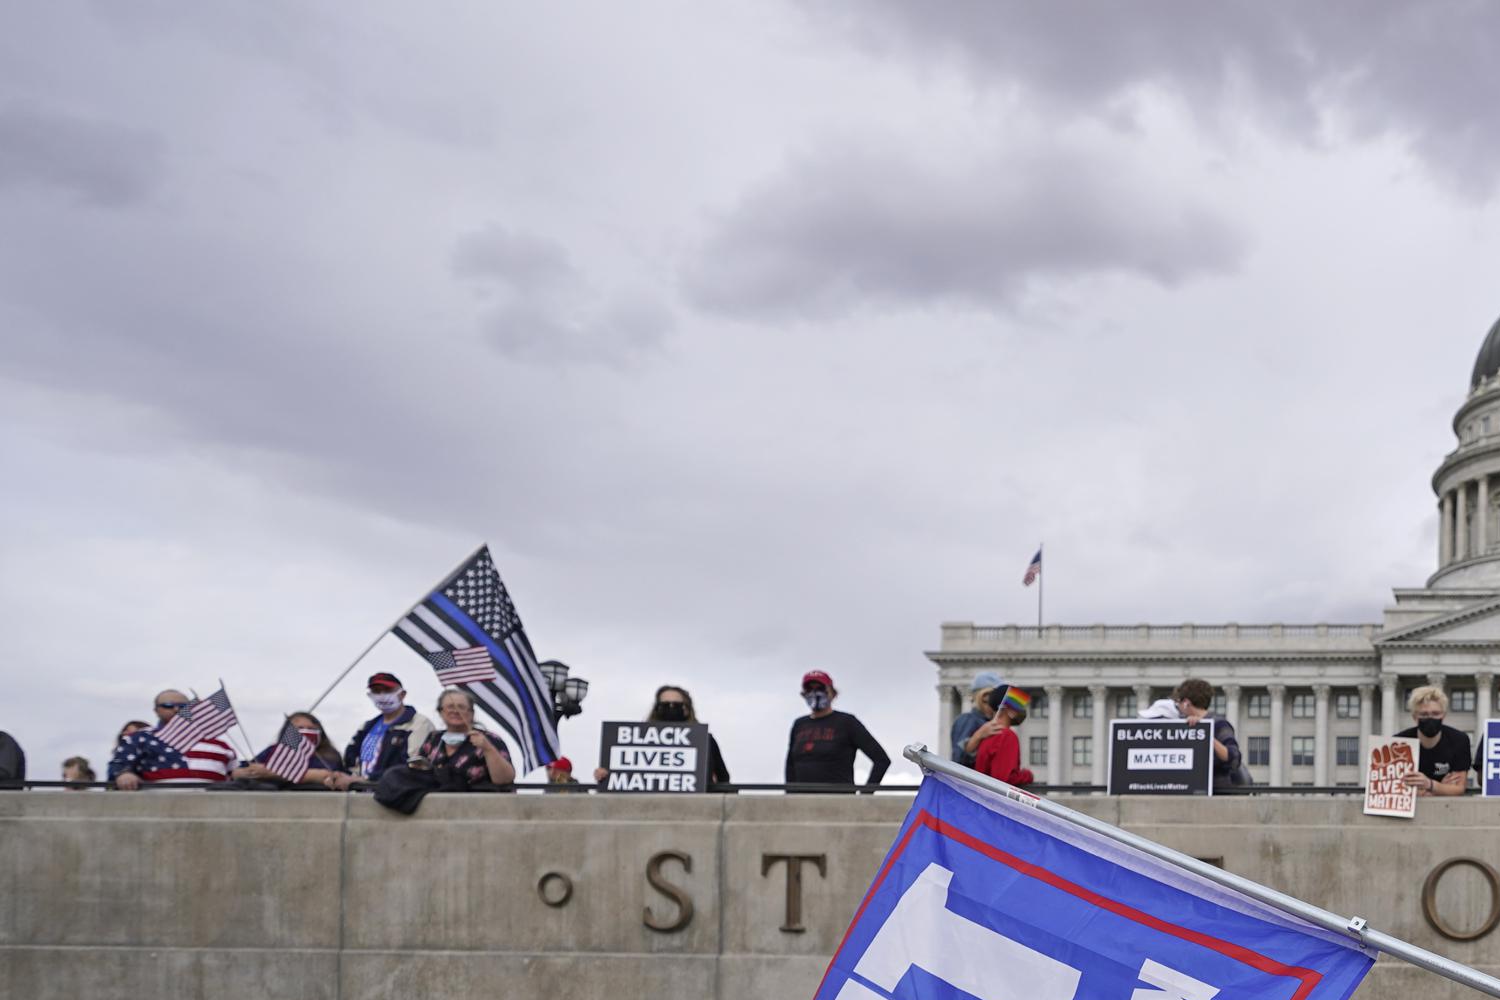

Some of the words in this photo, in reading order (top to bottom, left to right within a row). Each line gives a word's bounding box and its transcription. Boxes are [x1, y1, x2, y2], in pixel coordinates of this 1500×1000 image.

[617, 726, 691, 745] BLACK
[1117, 729, 1162, 740] BLACK
[1167, 729, 1206, 740] LIVES
[620, 750, 685, 767] LIVES
[1133, 753, 1186, 764] MATTER
[1370, 761, 1413, 781] BLACK
[607, 772, 696, 792] MATTER
[1369, 779, 1413, 796] LIVES
[1368, 794, 1412, 812] MATTER
